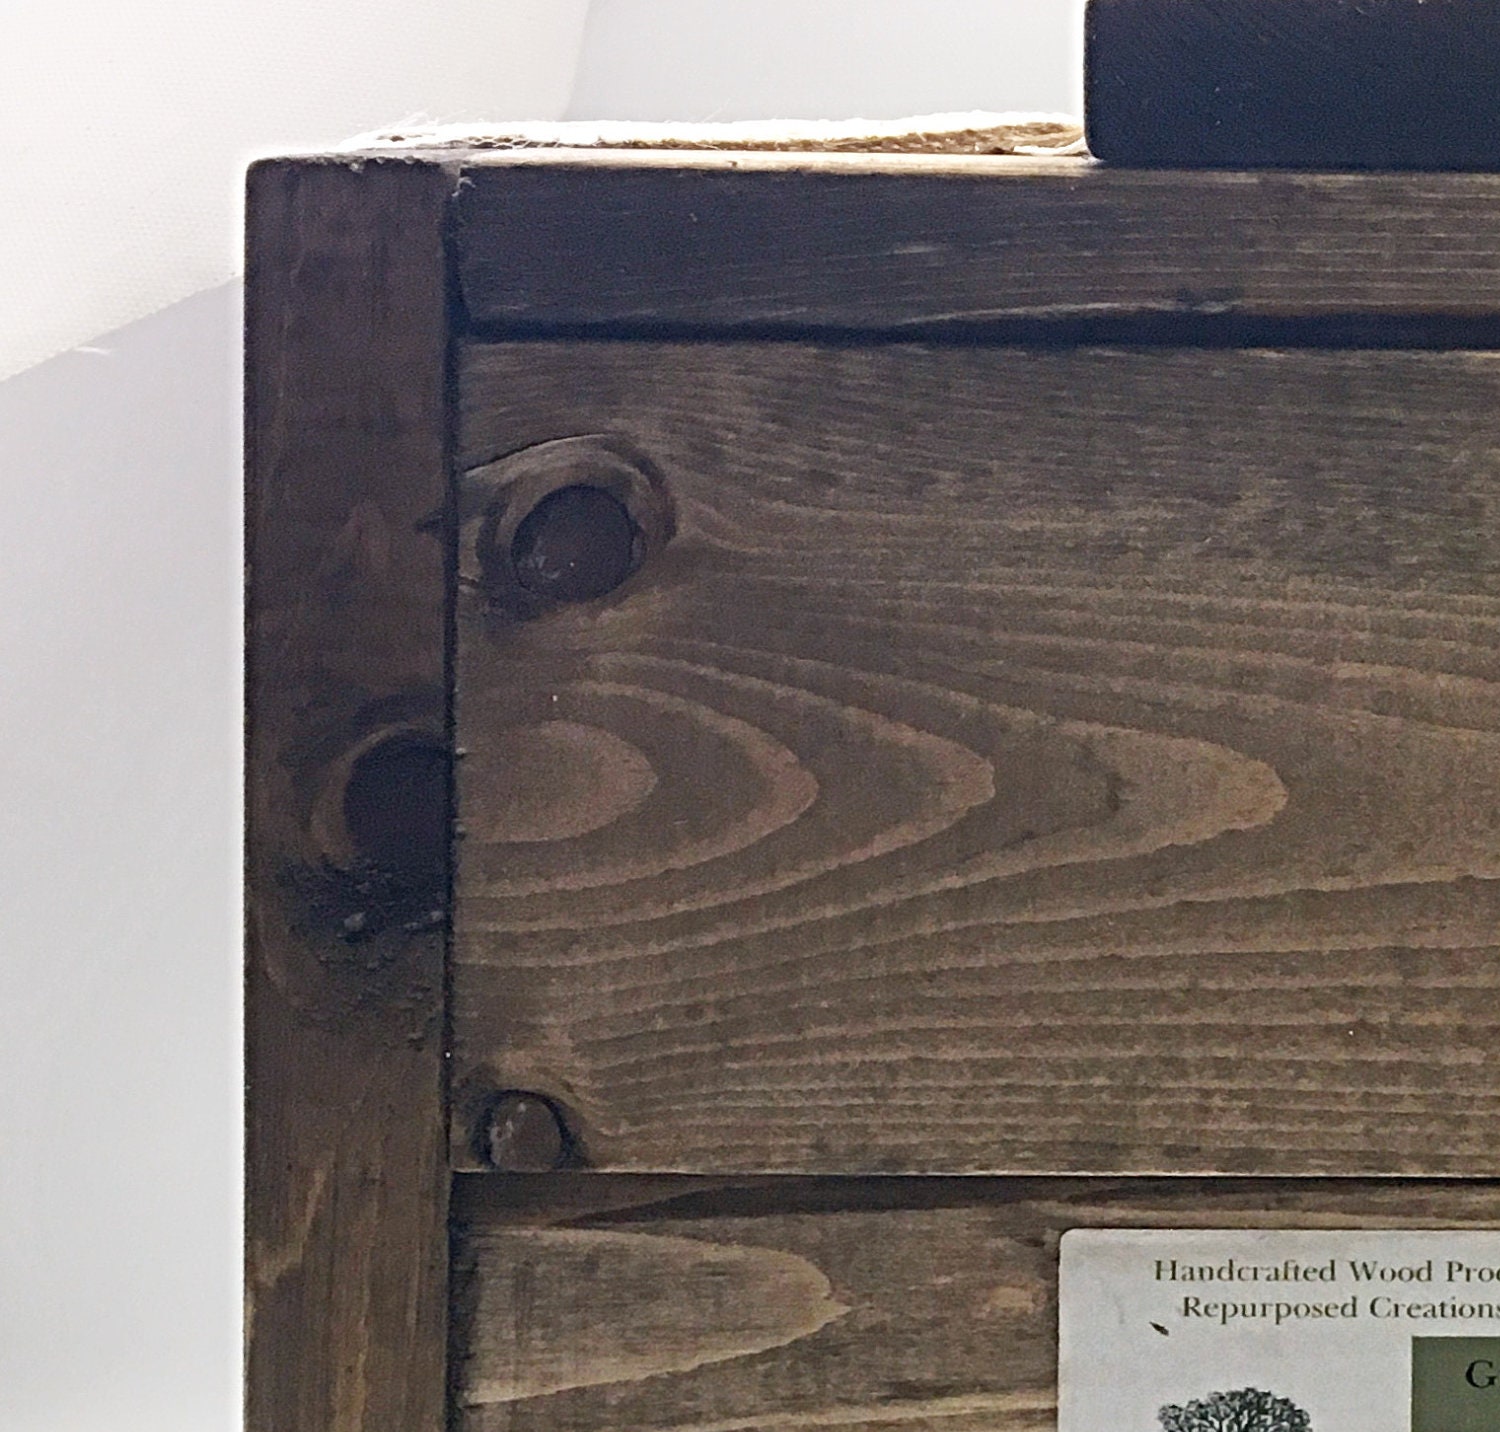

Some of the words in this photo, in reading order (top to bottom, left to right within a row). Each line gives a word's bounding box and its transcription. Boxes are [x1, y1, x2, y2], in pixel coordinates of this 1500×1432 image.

[1154, 1258, 1336, 1282] Handcrafted
[1349, 1259, 1433, 1282] Wood
[1183, 1295, 1358, 1324] Repurposed
